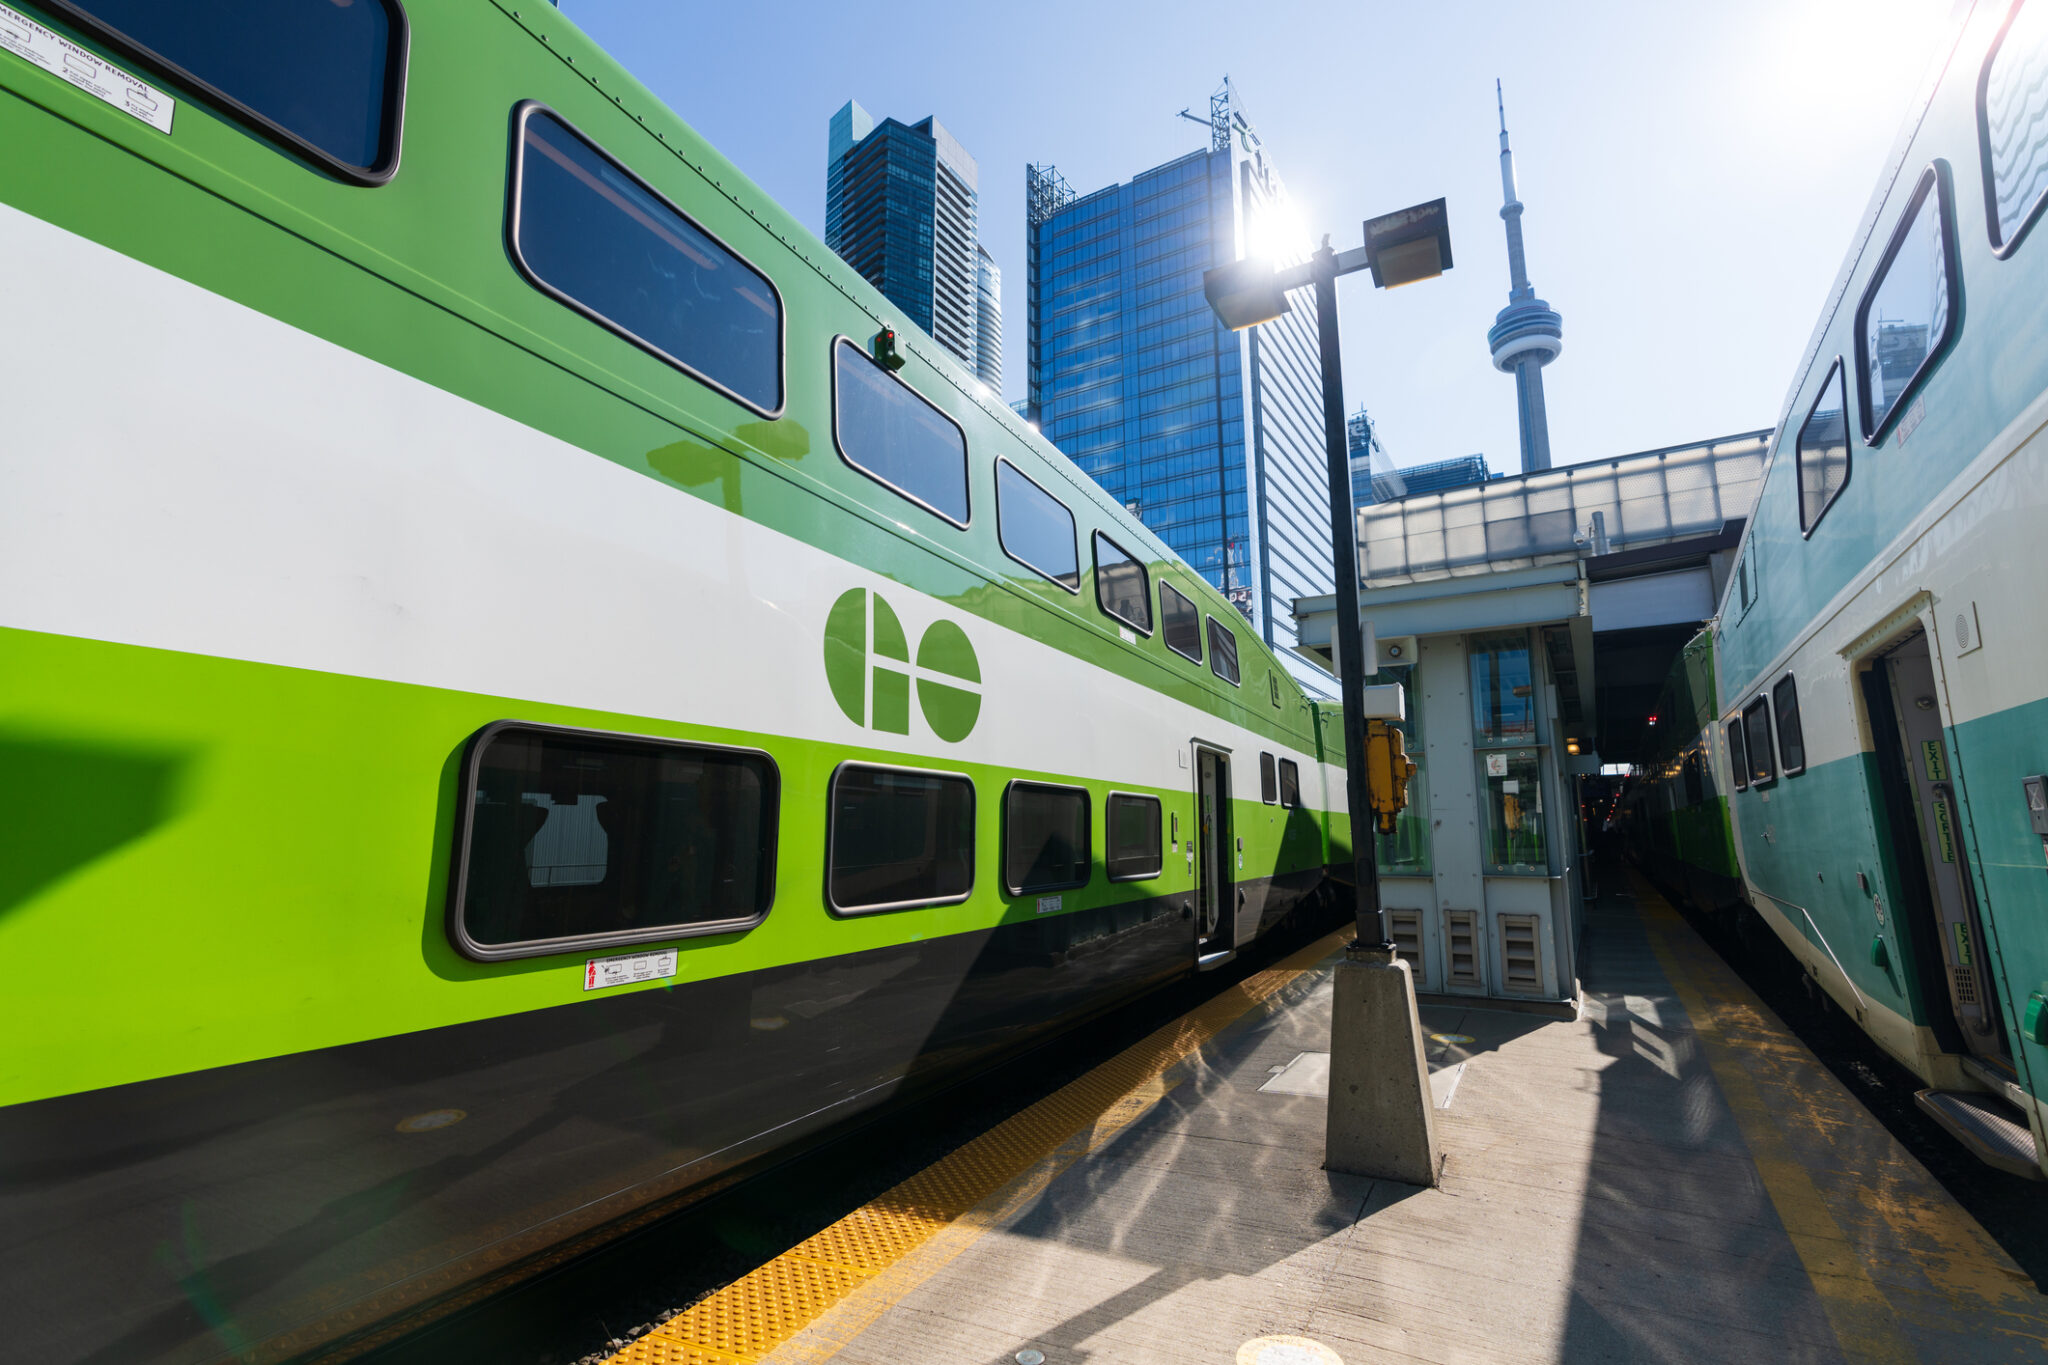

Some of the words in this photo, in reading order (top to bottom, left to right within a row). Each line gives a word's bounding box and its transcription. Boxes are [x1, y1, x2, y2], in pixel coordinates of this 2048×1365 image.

[59, 39, 102, 66] WINDOW
[105, 65, 149, 92] REMOVAL
[1927, 741, 1942, 779] EXIT
